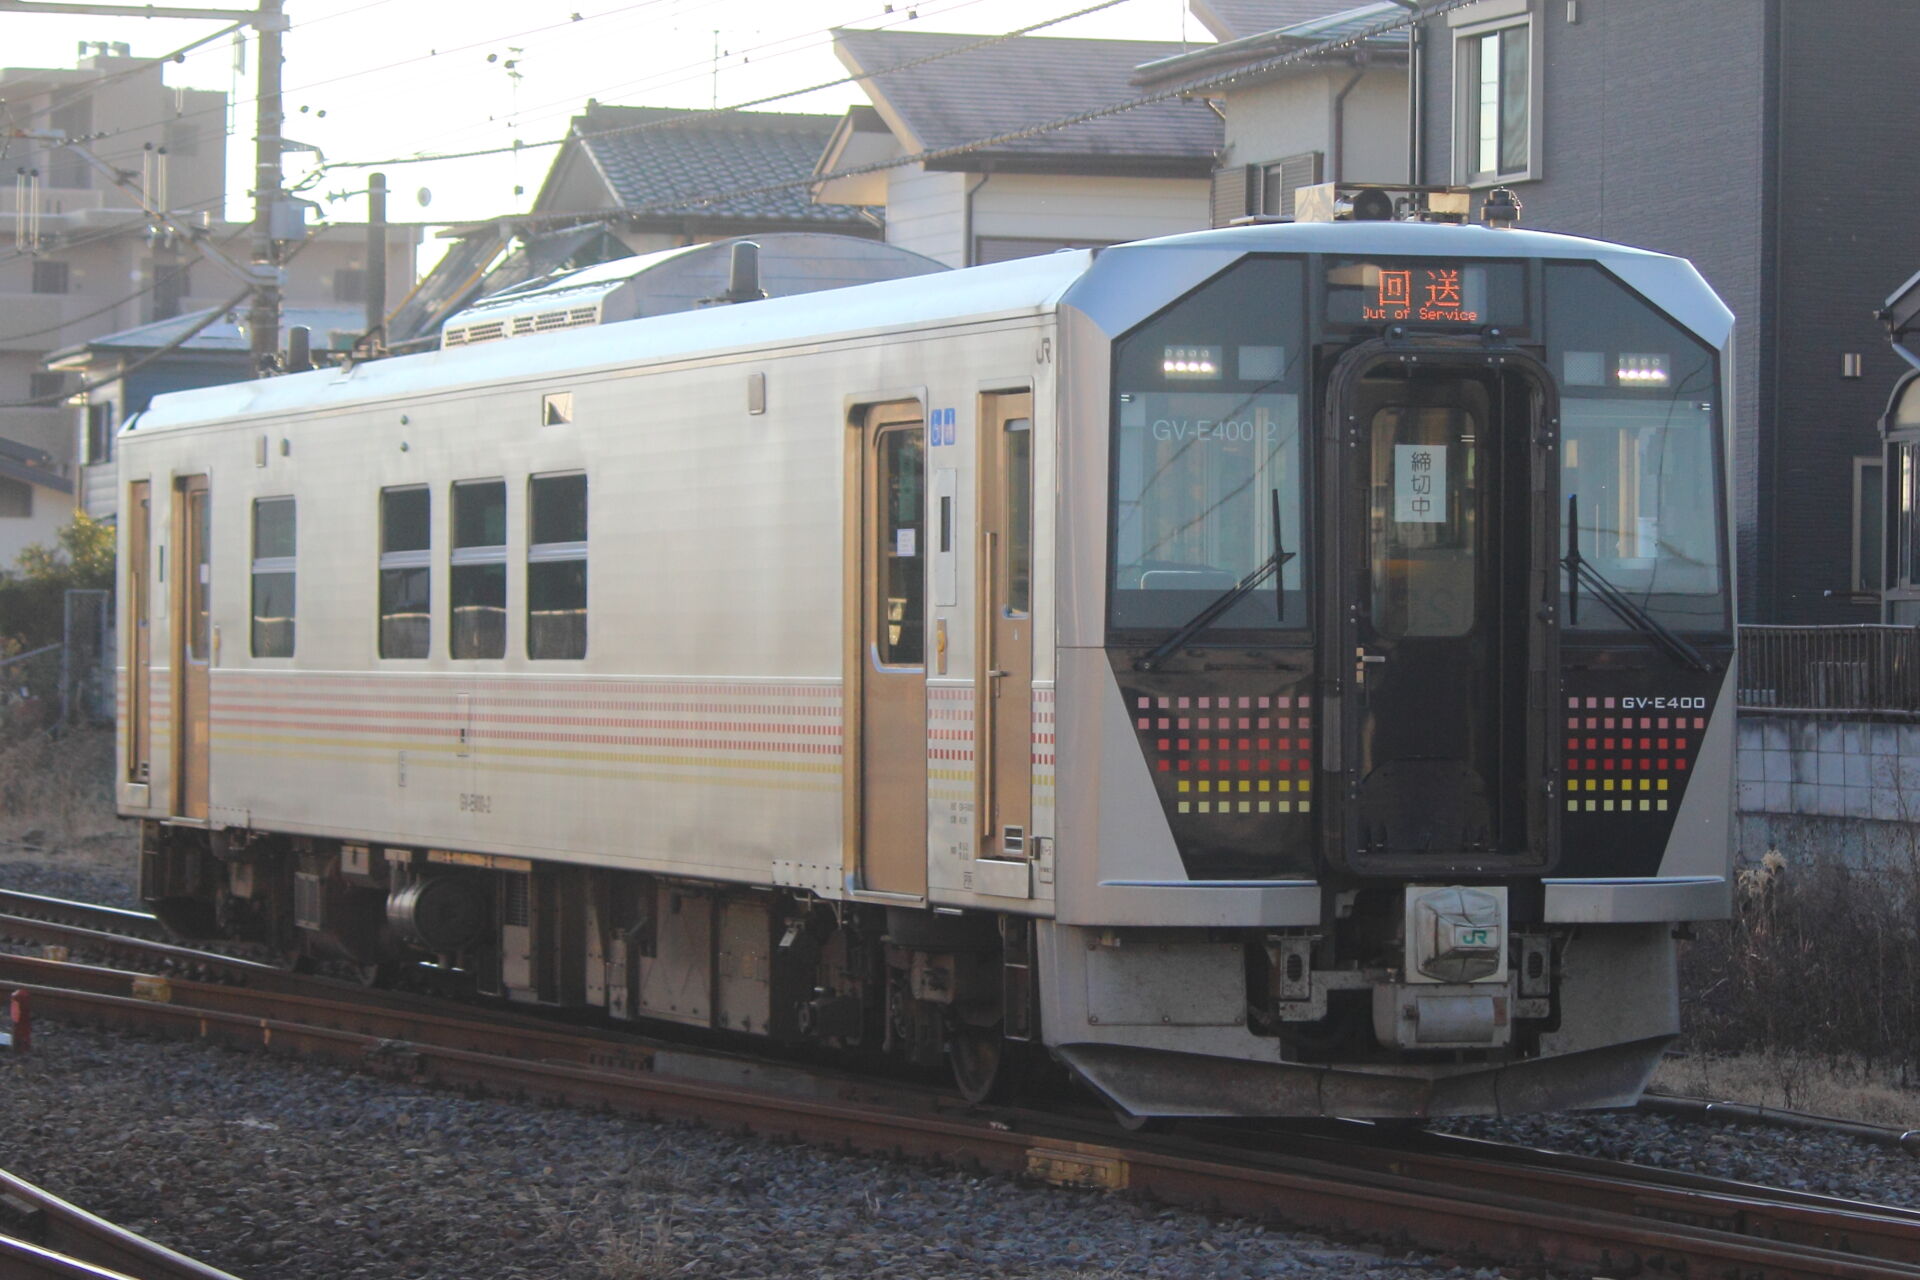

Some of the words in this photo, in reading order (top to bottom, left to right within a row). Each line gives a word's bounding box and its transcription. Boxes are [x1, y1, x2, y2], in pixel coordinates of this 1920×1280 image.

[1379, 269, 1460, 307] 回送
[1394, 307, 1411, 320] of
[1419, 307, 1477, 321] Service
[1036, 337, 1051, 365] JR
[1411, 451, 1432, 516] 締切中
[1622, 697, 1705, 709] GV-E400
[1462, 929, 1488, 945] JR
